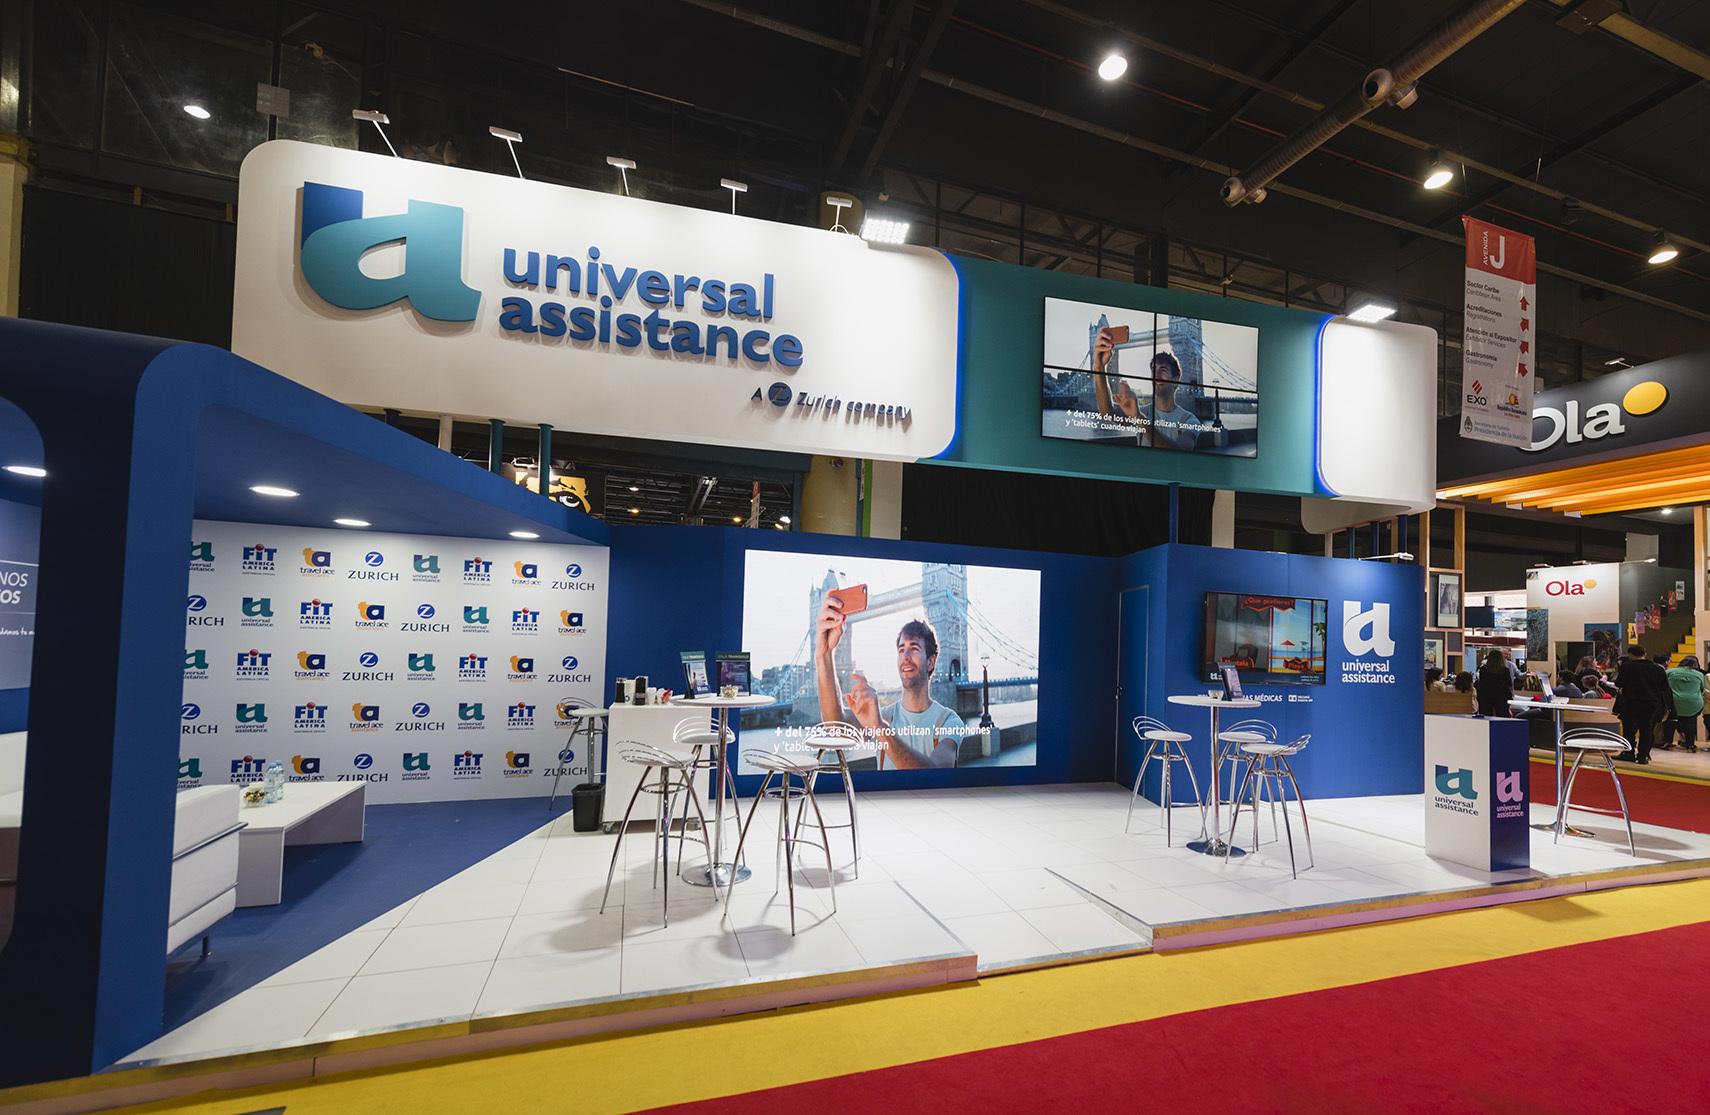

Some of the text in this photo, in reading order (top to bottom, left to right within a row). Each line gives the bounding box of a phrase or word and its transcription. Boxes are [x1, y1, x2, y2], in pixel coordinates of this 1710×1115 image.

[1490, 235, 1505, 269] J
[503, 246, 774, 319] universal
[1466, 280, 1500, 294] Sector Caribe
[1466, 304, 1502, 318] Acreditaciones
[499, 295, 803, 367] assistance
[1466, 326, 1488, 336] Atención
[1494, 332, 1518, 343] Expositor
[751, 387, 763, 401] A
[797, 392, 842, 410] Zurich
[847, 401, 912, 420] company
[1466, 394, 1487, 406] EXO
[1072, 418, 1100, 428] 'tablets'
[1100, 423, 1126, 432] cuando
[1126, 426, 1146, 434] viajan
[1074, 410, 1086, 418] del
[1086, 412, 1102, 420] 75%
[1103, 413, 1112, 422] de
[1114, 414, 1124, 422] los
[1124, 415, 1151, 426] viajeros
[1178, 422, 1222, 432] 'smartphones'
[1519, 400, 1625, 452] Ola
[1474, 426, 1500, 436] Presidencia
[348, 570, 399, 581] ZURICH
[552, 581, 595, 591] ZURICH
[1545, 580, 1585, 596] Ola
[0, 590, 21, 604] OS
[1263, 598, 1294, 607] prefieres?
[188, 616, 224, 626] RICH
[400, 622, 450, 632] ZURICH
[1342, 658, 1390, 672] universal
[342, 672, 394, 681] ZURICH
[547, 674, 591, 683] ZURICH
[1342, 671, 1396, 684] assistance
[1254, 693, 1282, 702] MÉDICAS
[182, 724, 218, 734] RICH
[395, 722, 445, 731] ZURICH
[786, 726, 802, 738] del
[860, 725, 896, 738] viajeros
[898, 725, 930, 736] utilizan
[932, 724, 993, 738] 'smartphones'
[774, 743, 780, 754] y
[863, 740, 889, 752] viajan
[1434, 796, 1474, 808] universal
[1496, 803, 1521, 812] universal
[1434, 802, 1479, 816] assistance
[1496, 810, 1524, 818] assistance
